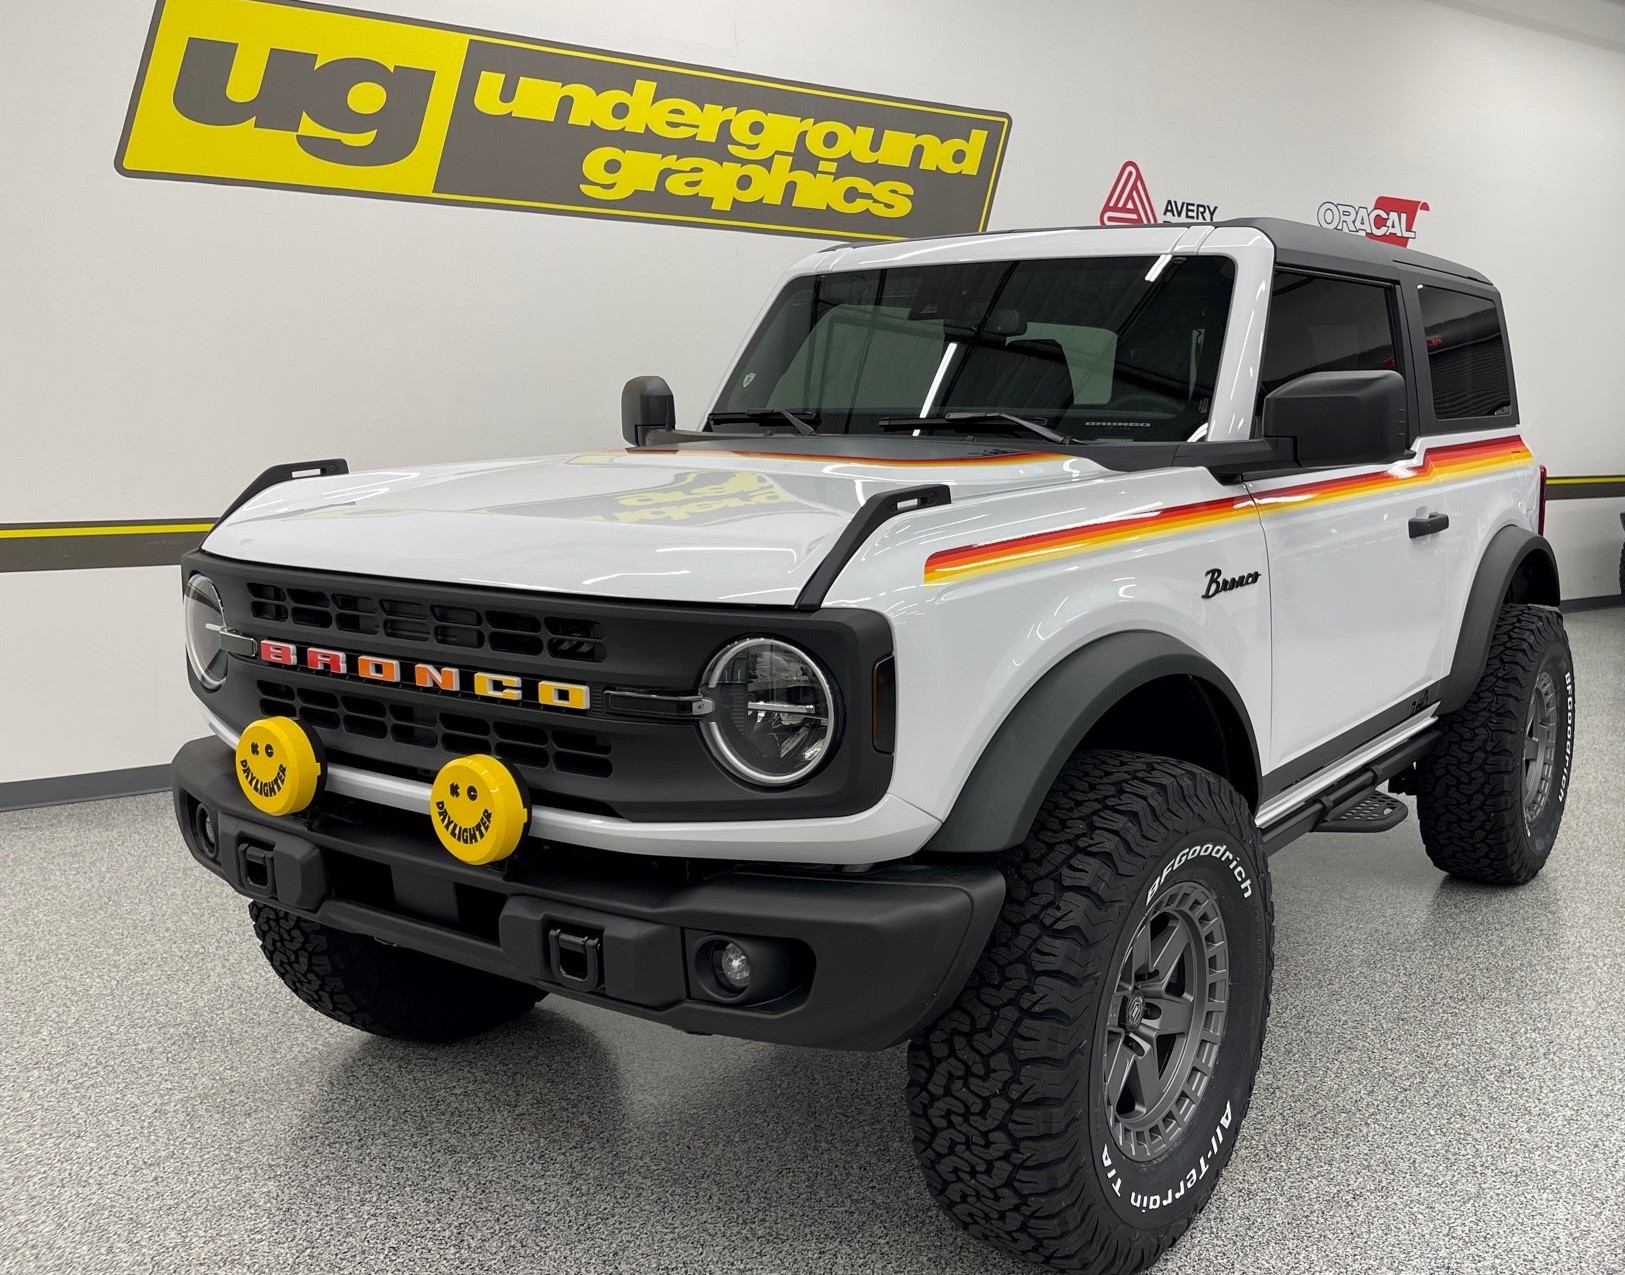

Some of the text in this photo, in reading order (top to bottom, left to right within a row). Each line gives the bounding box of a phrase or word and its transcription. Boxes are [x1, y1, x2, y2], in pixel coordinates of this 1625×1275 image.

[173, 37, 436, 166] ug
[474, 70, 988, 175] underground
[579, 146, 914, 218] graphics
[1163, 199, 1218, 222] AVERY
[1317, 201, 1416, 239] ORACAL
[1201, 568, 1261, 599] Bronco
[260, 639, 591, 710] BRONCO
[240, 759, 286, 797] DAYLIGHTER
[436, 800, 492, 844] DAYLIGHTER
[1146, 843, 1252, 906] BFGoodrich
